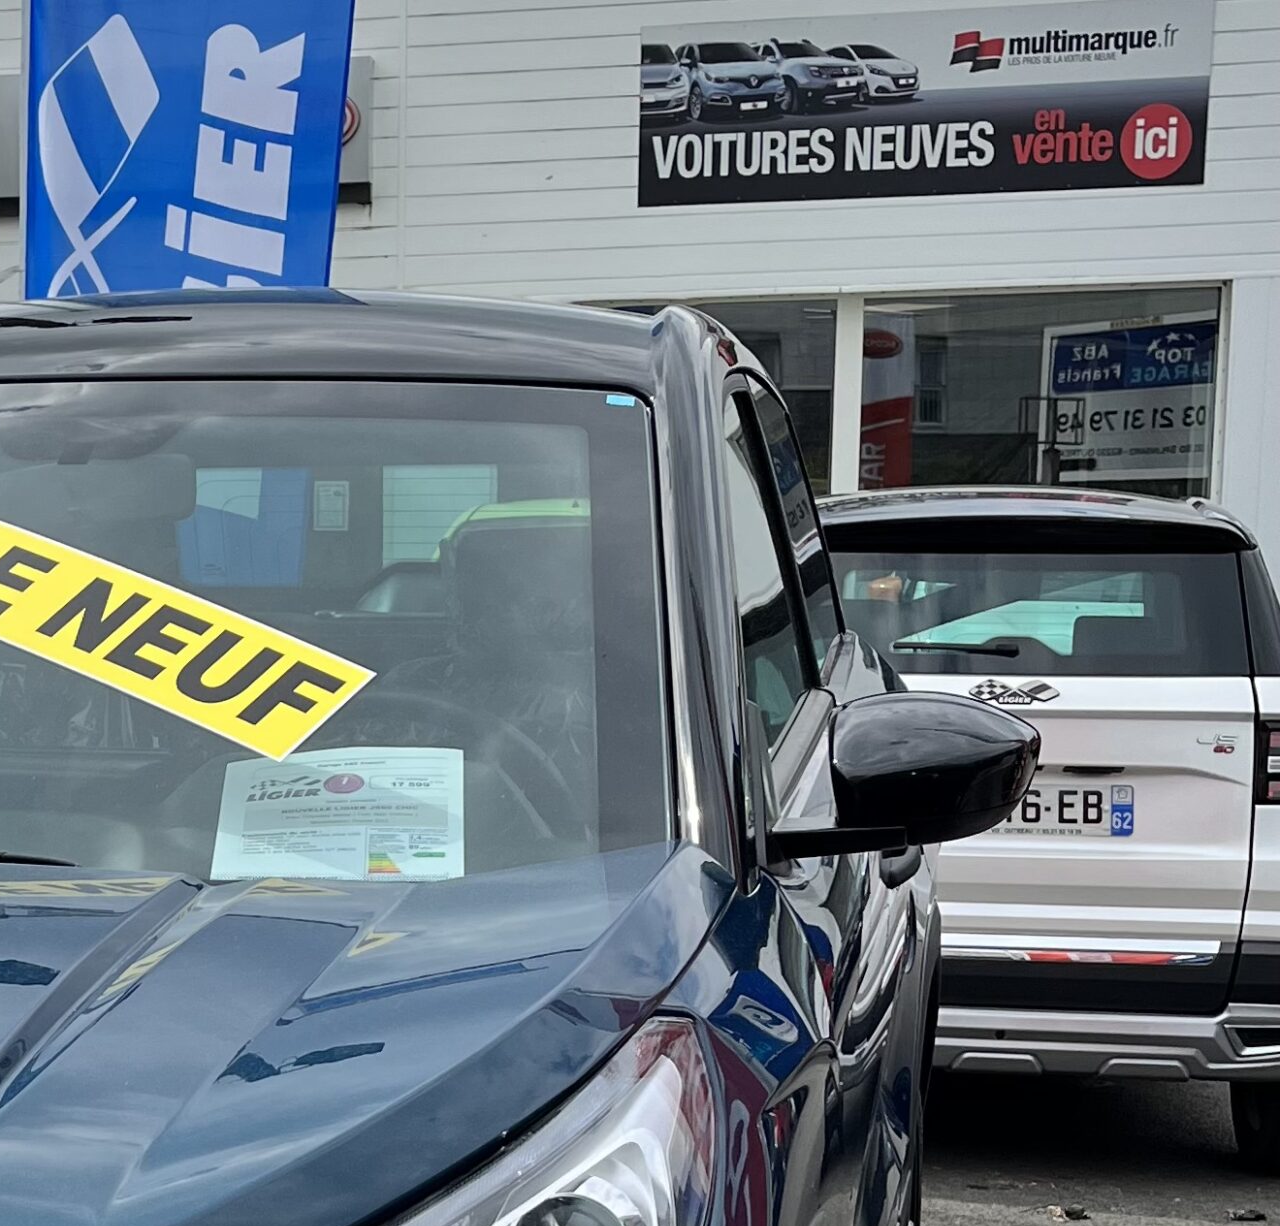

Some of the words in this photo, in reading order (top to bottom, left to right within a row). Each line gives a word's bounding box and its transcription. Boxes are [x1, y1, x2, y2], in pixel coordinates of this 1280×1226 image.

[1009, 23, 1179, 55] multimarque.fr
[1022, 54, 1041, 65] PROS
[1064, 52, 1093, 63] VOITURE
[1034, 106, 1065, 132] en
[652, 127, 835, 180] VOITURES
[844, 120, 996, 172] NEUVES
[1012, 123, 1114, 166] vente
[1134, 116, 1178, 160] ici
[36, 578, 345, 726] NEUF
[1006, 790, 1103, 824] 6-EB
[1111, 812, 1132, 830] 62
